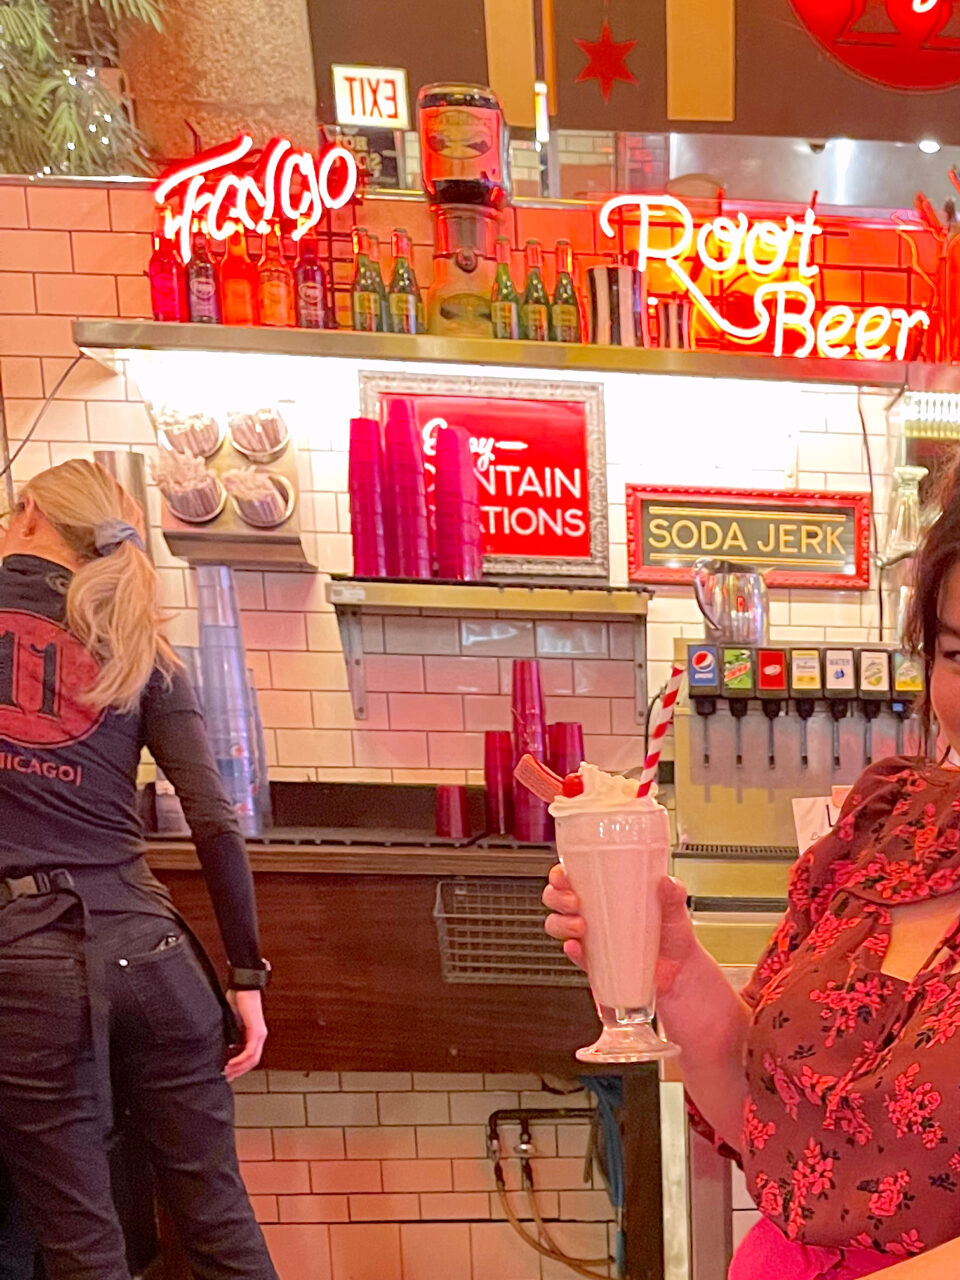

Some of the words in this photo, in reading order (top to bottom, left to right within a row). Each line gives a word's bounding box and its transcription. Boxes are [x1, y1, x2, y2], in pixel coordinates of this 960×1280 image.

[599, 195, 823, 337] Root
[754, 281, 930, 361] Beer
[473, 464, 582, 499] NTAIN
[480, 506, 586, 537] TIONS
[648, 518, 749, 552] SODA
[756, 523, 847, 555] JERK
